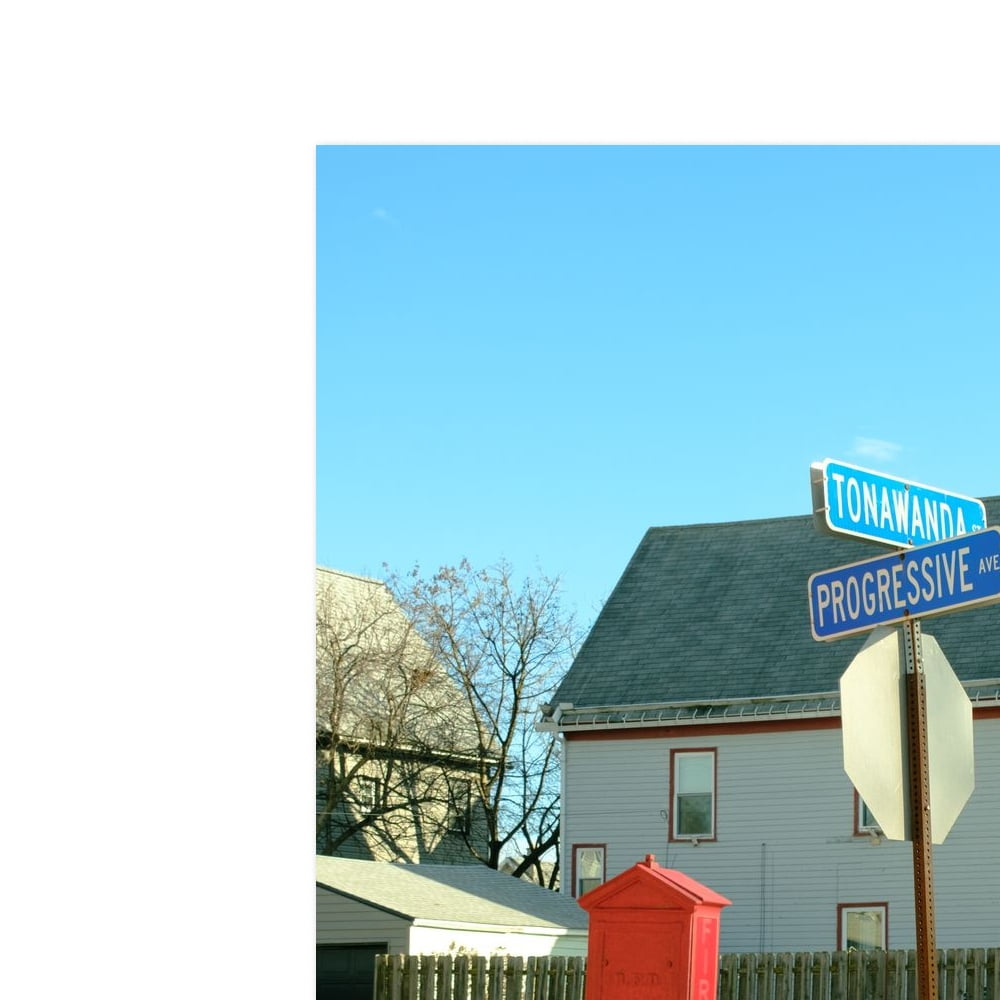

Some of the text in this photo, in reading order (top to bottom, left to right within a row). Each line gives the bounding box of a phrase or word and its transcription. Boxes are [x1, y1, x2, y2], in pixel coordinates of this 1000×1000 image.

[832, 473, 967, 541] TONAWANDA
[817, 546, 1000, 627] PROGRESSIVE AVE
